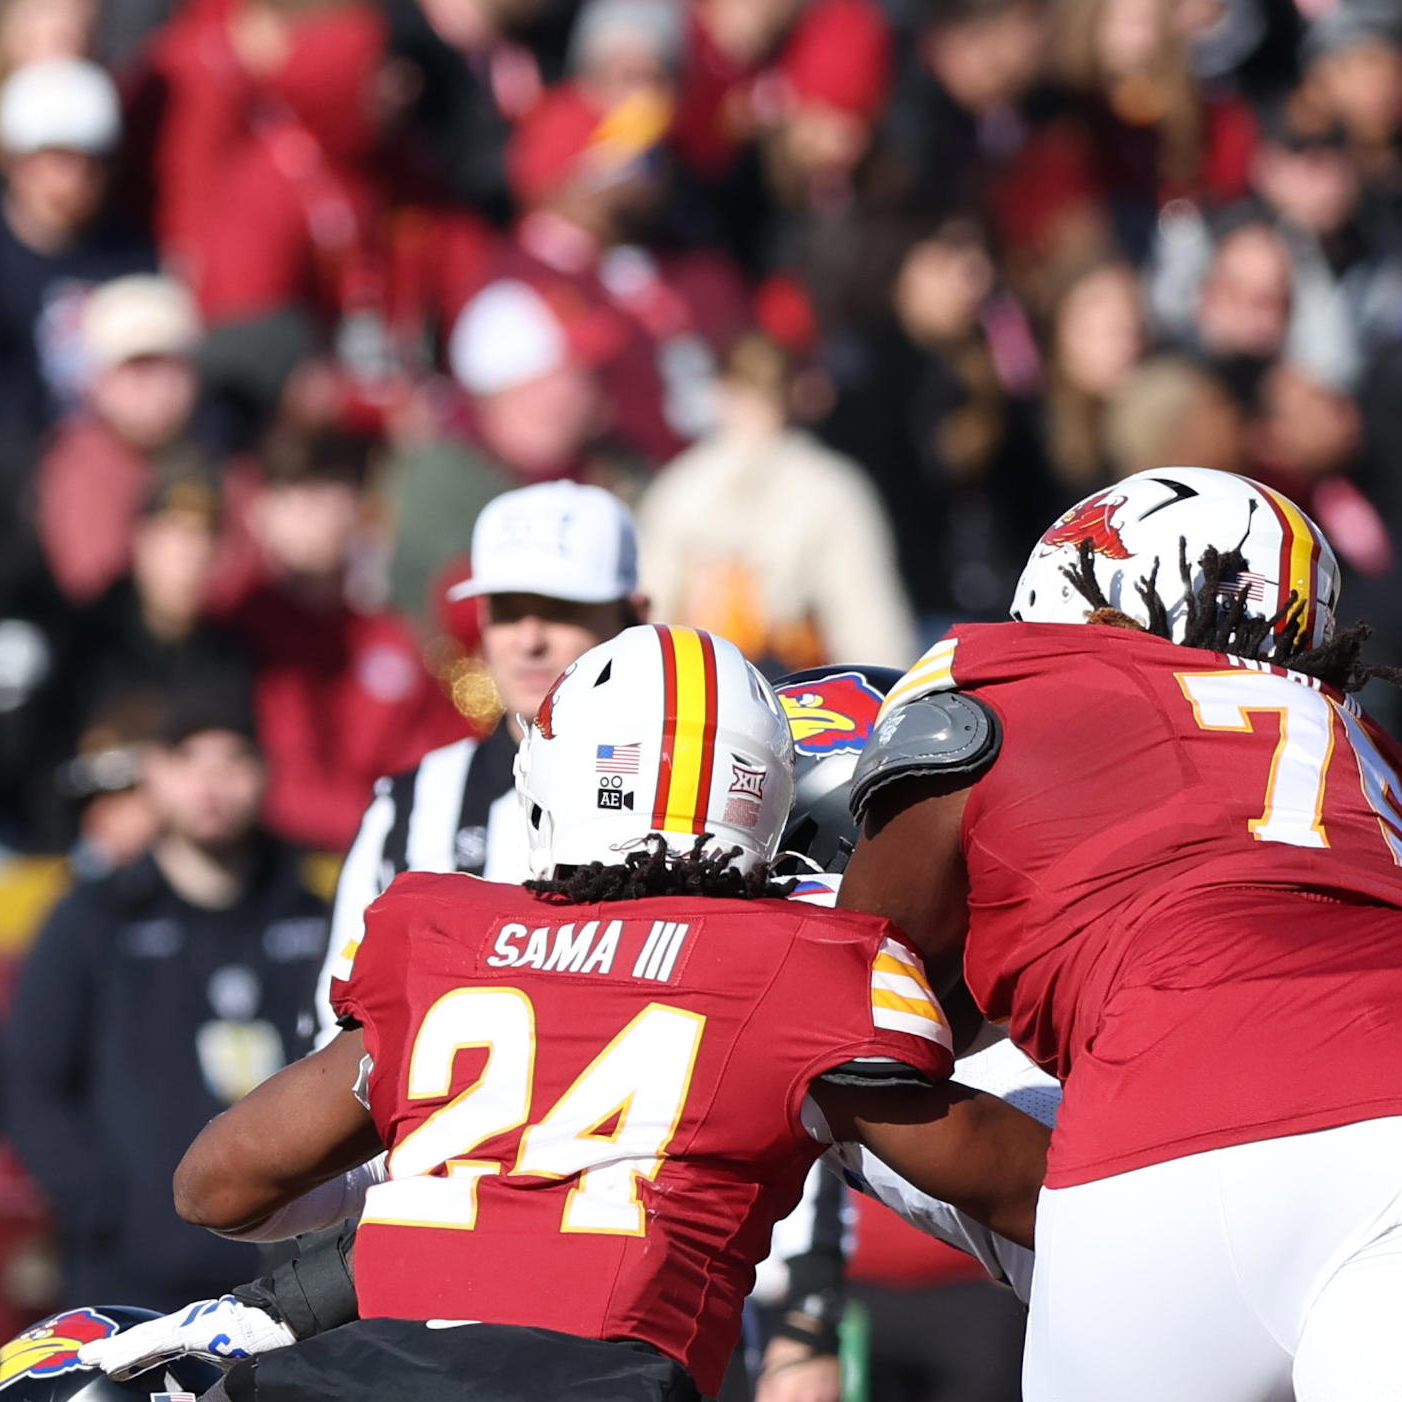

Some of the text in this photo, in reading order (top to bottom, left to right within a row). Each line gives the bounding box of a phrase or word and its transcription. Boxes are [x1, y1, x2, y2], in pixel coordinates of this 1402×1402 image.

[600, 792, 621, 807] AE
[729, 765, 766, 799] XII
[487, 920, 690, 983] SAMA III
[360, 987, 707, 1238] 24
